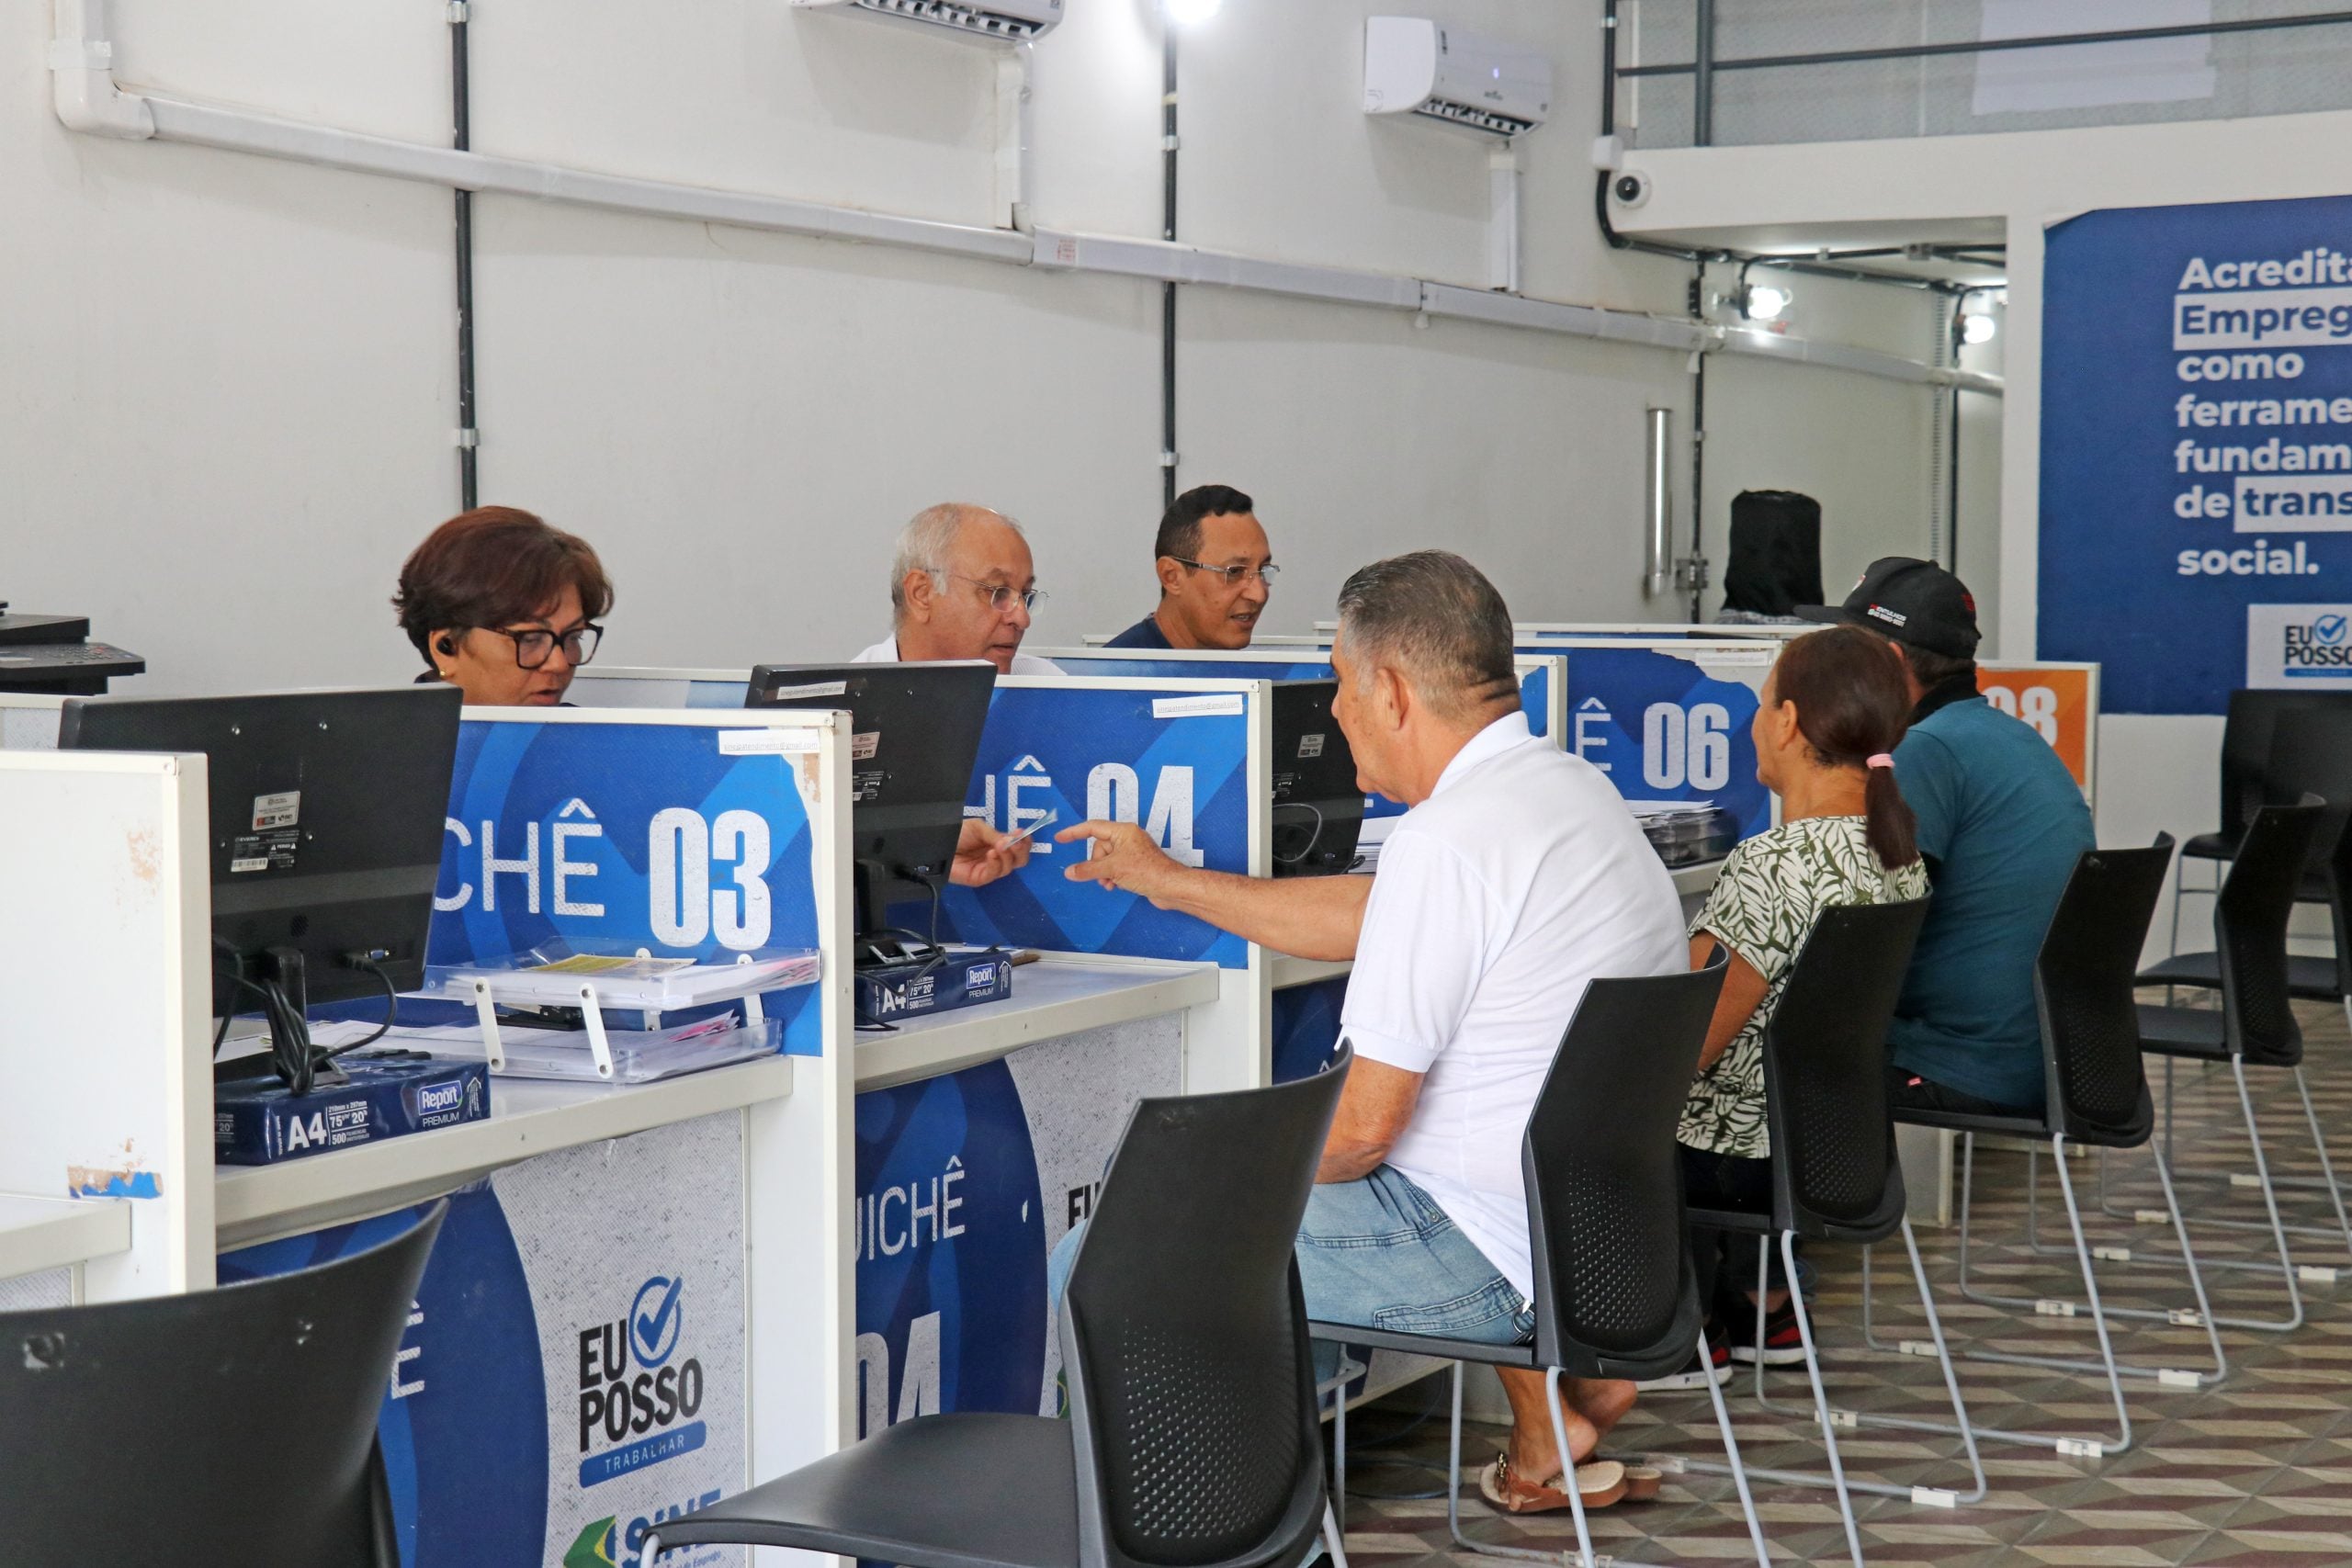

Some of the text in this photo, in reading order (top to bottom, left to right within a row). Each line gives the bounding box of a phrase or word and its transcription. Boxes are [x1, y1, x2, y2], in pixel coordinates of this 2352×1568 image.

[2178, 247, 2352, 290] Acredit
[2177, 352, 2304, 382] como
[2175, 395, 2352, 427] ferrame
[2174, 437, 2352, 473] fundam
[2174, 486, 2230, 519] de
[2177, 540, 2320, 576] social.
[2285, 626, 2312, 645] EU
[1644, 702, 1730, 791] 06
[649, 807, 771, 950] 03
[968, 987, 993, 998] PREMIUM
[969, 967, 993, 985] Report
[882, 984, 907, 1013] A4
[423, 1087, 458, 1110] Report
[288, 1112, 327, 1152] A4
[423, 1111, 459, 1127] PREMIUM
[332, 1133, 346, 1145] 500
[855, 1155, 966, 1263] ICHÊ
[580, 1319, 627, 1391] EU
[580, 1358, 703, 1453] POSSO
[605, 1434, 684, 1473] TRABALHAR
